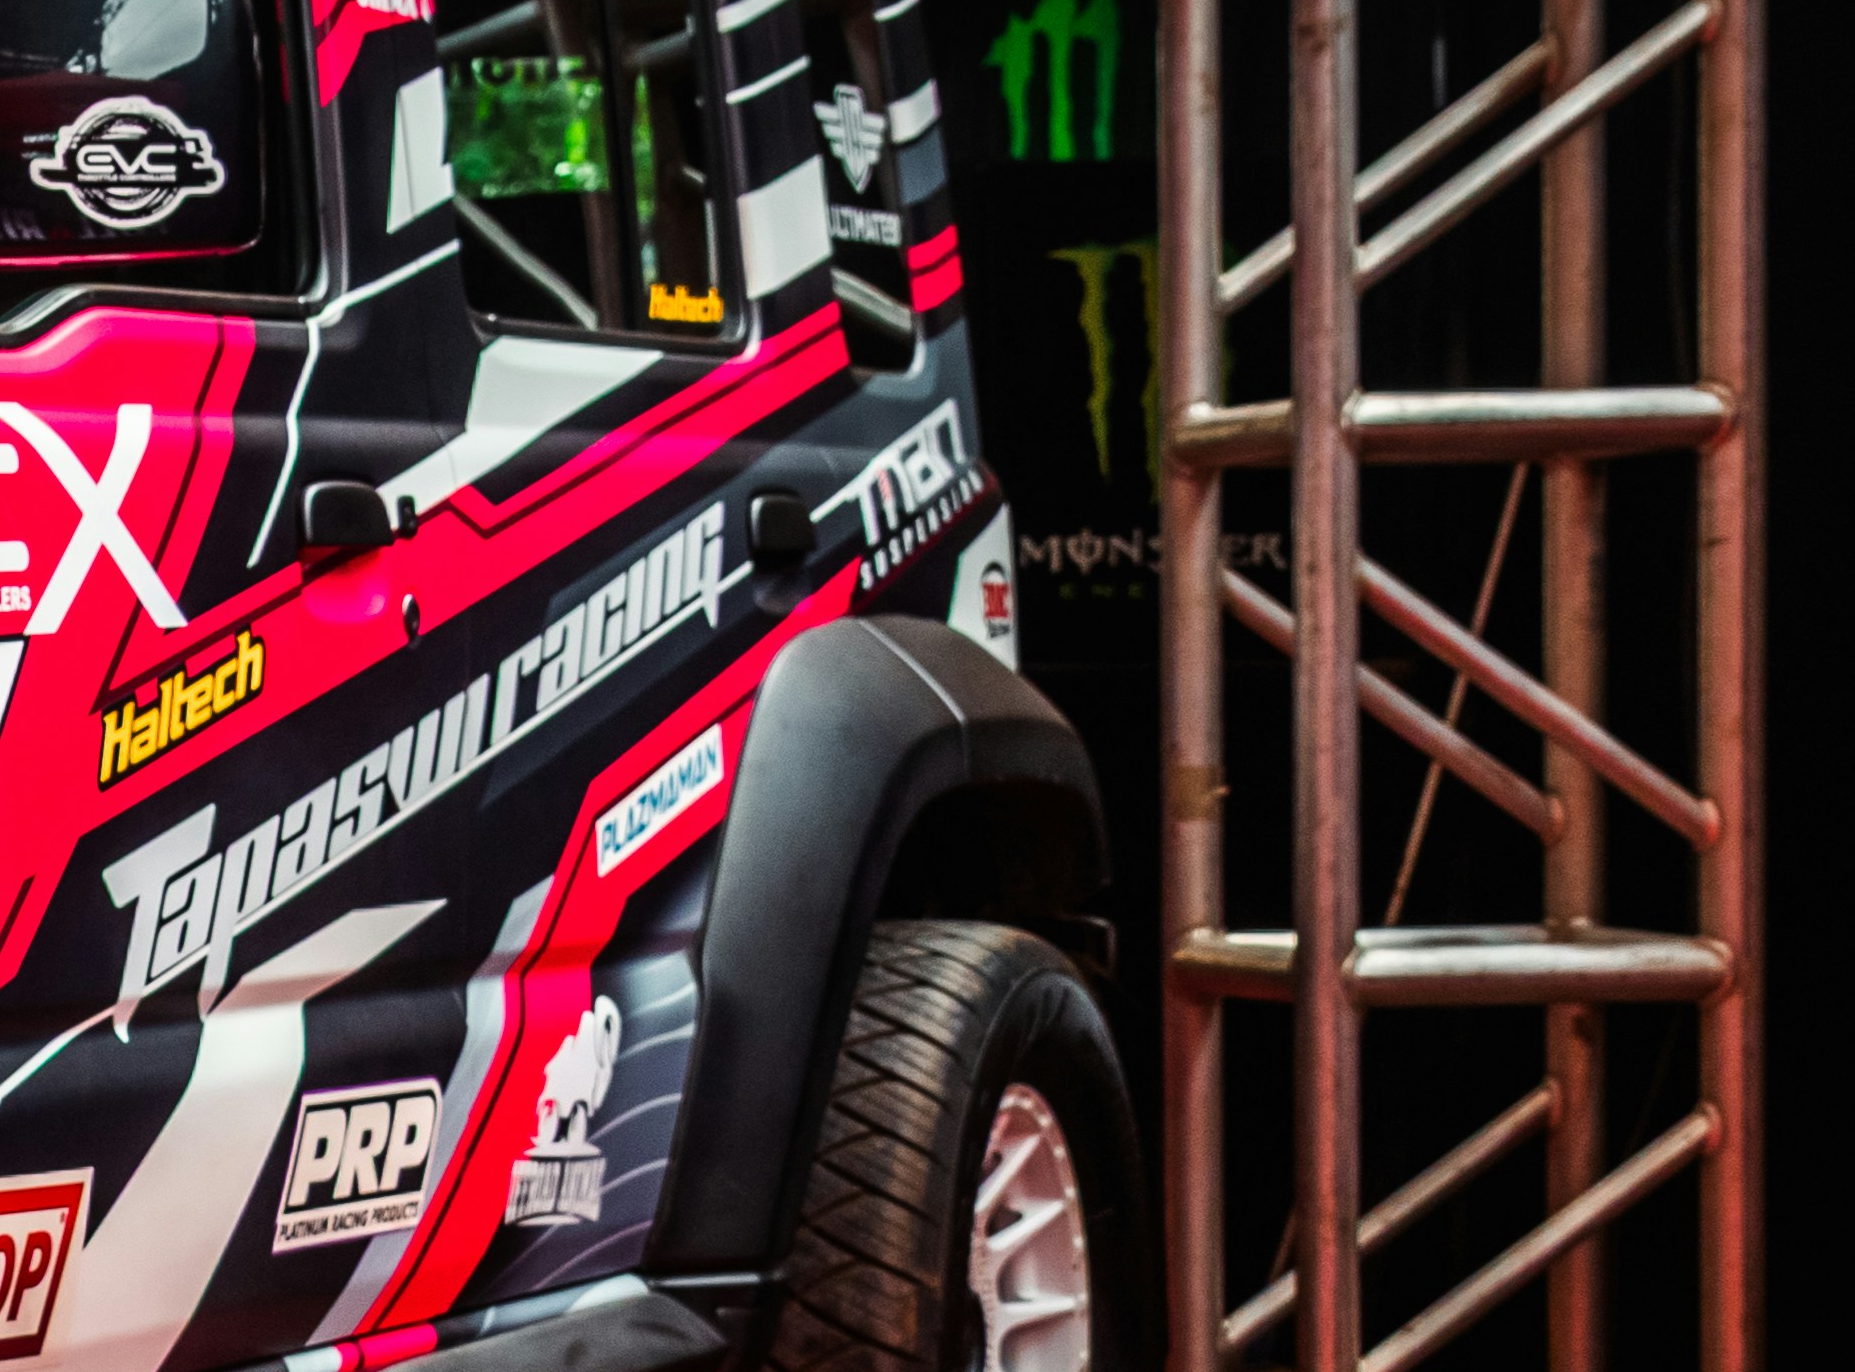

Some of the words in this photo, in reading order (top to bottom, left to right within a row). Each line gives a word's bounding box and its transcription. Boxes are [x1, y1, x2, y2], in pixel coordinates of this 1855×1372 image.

[76, 144, 176, 174] EVC
[1019, 528, 1288, 575] MONER
[100, 629, 265, 783] Haltech
[601, 735, 718, 865] PLAZMAMAN
[288, 1095, 436, 1207] PRP
[332, 1208, 369, 1231] RACING
[370, 1201, 420, 1224] PRODUCTS
